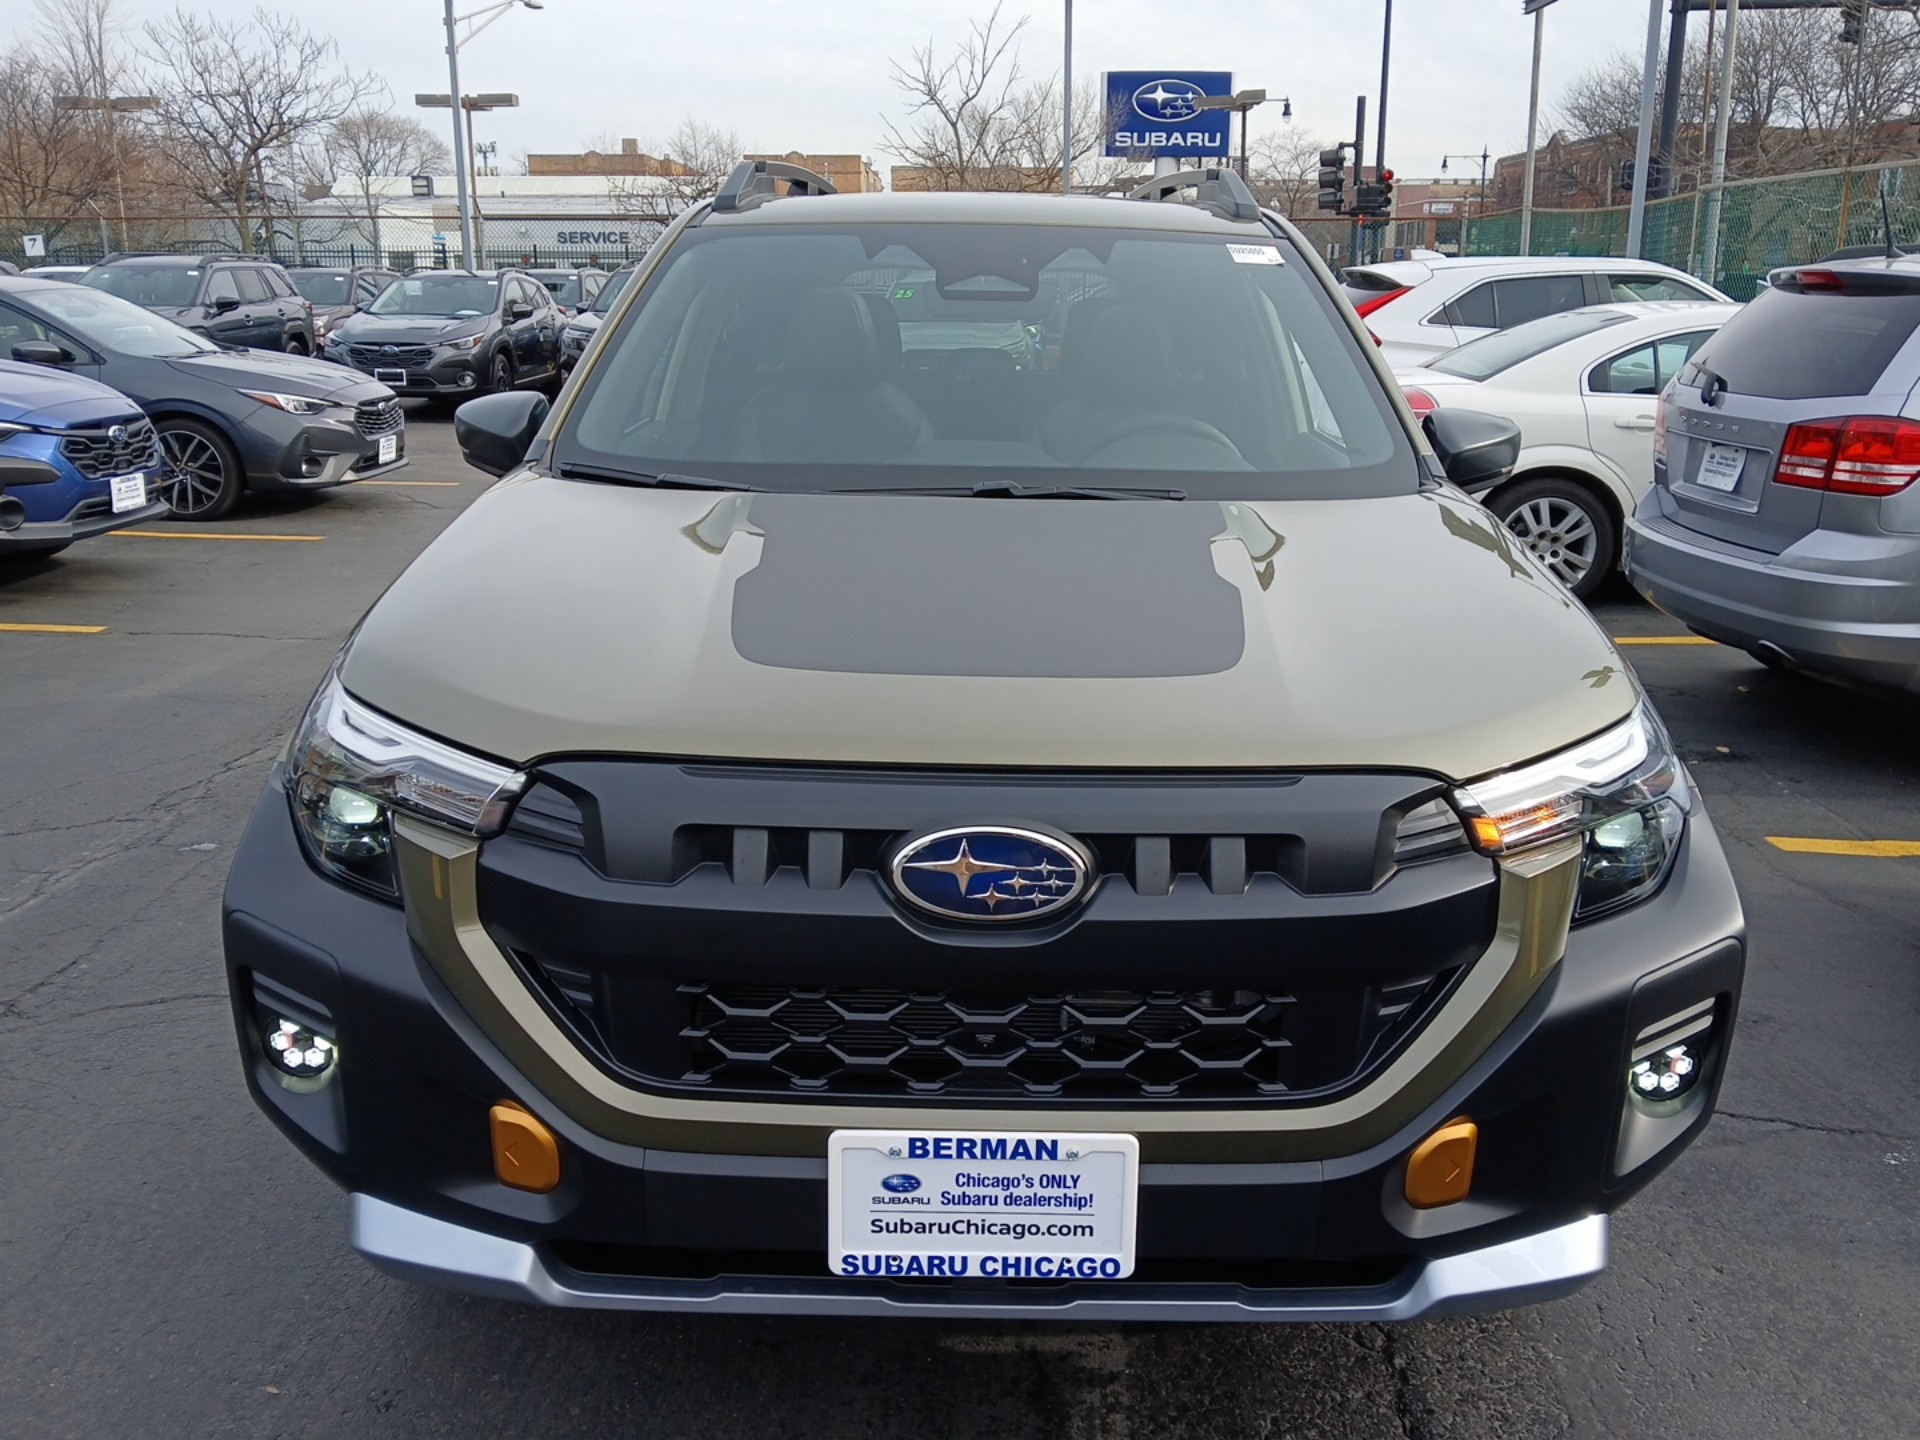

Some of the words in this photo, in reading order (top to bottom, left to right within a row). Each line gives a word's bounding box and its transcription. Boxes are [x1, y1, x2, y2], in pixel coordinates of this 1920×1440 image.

[1115, 132, 1221, 147] SUBARU
[28, 237, 37, 249] 7
[557, 231, 630, 244] SERVICE
[908, 1137, 1058, 1161] BERMAN
[955, 1173, 1034, 1190] Chicago's
[1039, 1174, 1081, 1189] ONLY
[871, 1196, 931, 1205] SUBARU
[940, 1191, 999, 1207] Subaru
[1003, 1192, 1093, 1210] dealership!
[870, 1218, 1094, 1240] SubaruChicago.com
[841, 1254, 969, 1277] SUBARU
[979, 1256, 1121, 1278] CHICAGO
